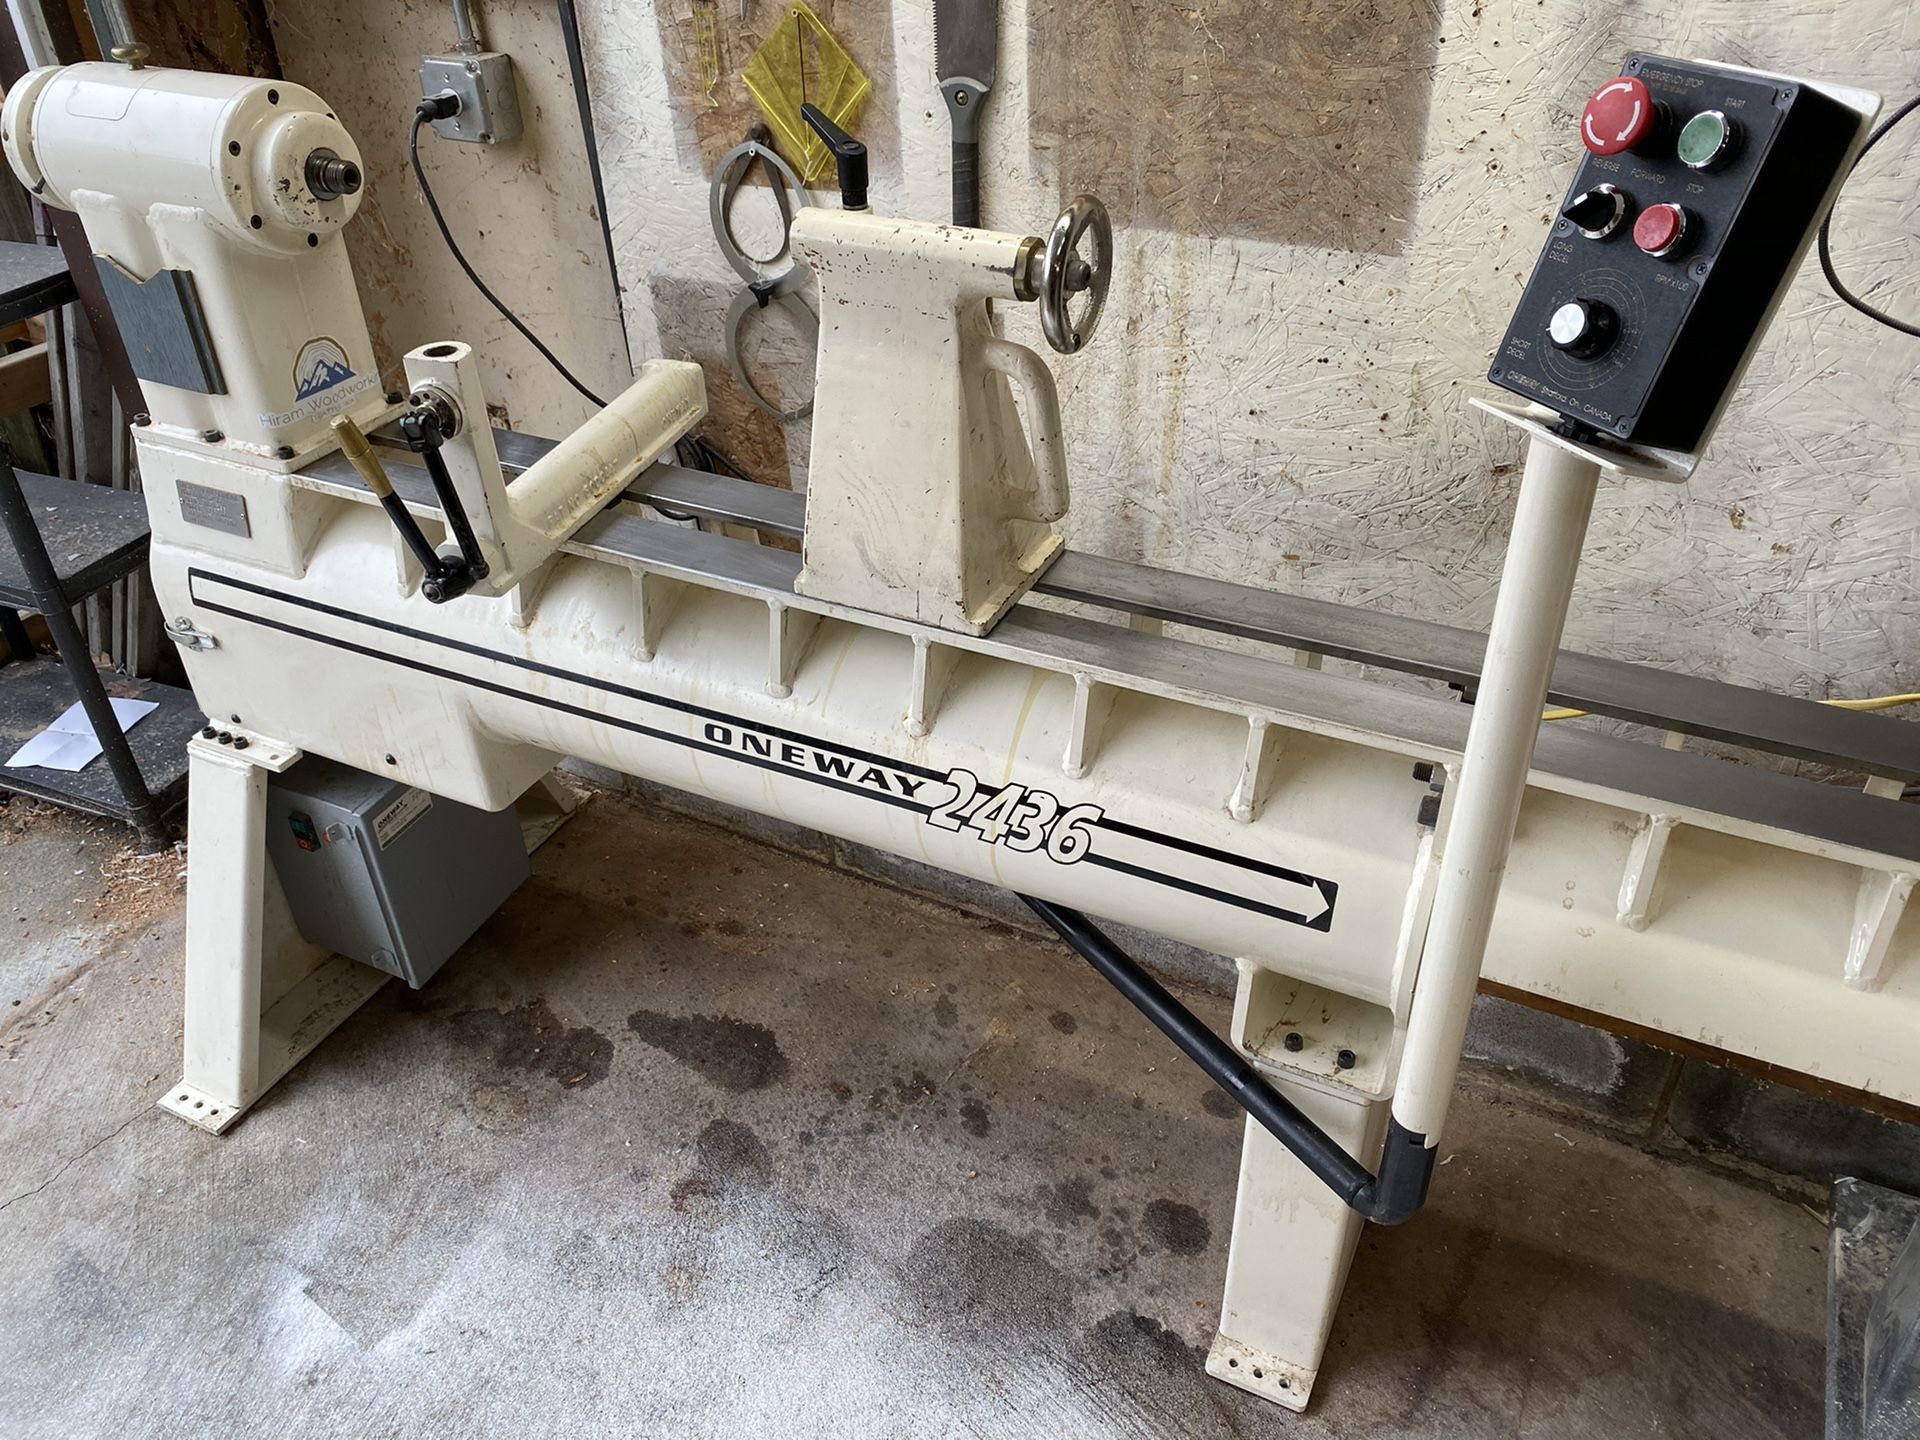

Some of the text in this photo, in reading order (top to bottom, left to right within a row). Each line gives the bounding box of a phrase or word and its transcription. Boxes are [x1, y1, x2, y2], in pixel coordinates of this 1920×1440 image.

[1641, 67, 1705, 88] EMERGENCY STOP
[1725, 97, 1746, 109] START
[1592, 157, 1620, 173] REVERSE
[1631, 168, 1666, 184] FORWARD
[1686, 183, 1704, 193] STOP
[1553, 241, 1574, 253] LONG
[1549, 250, 1569, 264] DECEL
[1511, 336, 1531, 349] SHORT
[1506, 346, 1526, 360] DECEL
[259, 407, 304, 427] Hiram
[1583, 403, 1612, 422] CANADA
[704, 722, 1106, 865] ONEWAY 2436
[378, 799, 404, 828] ONEWAY
